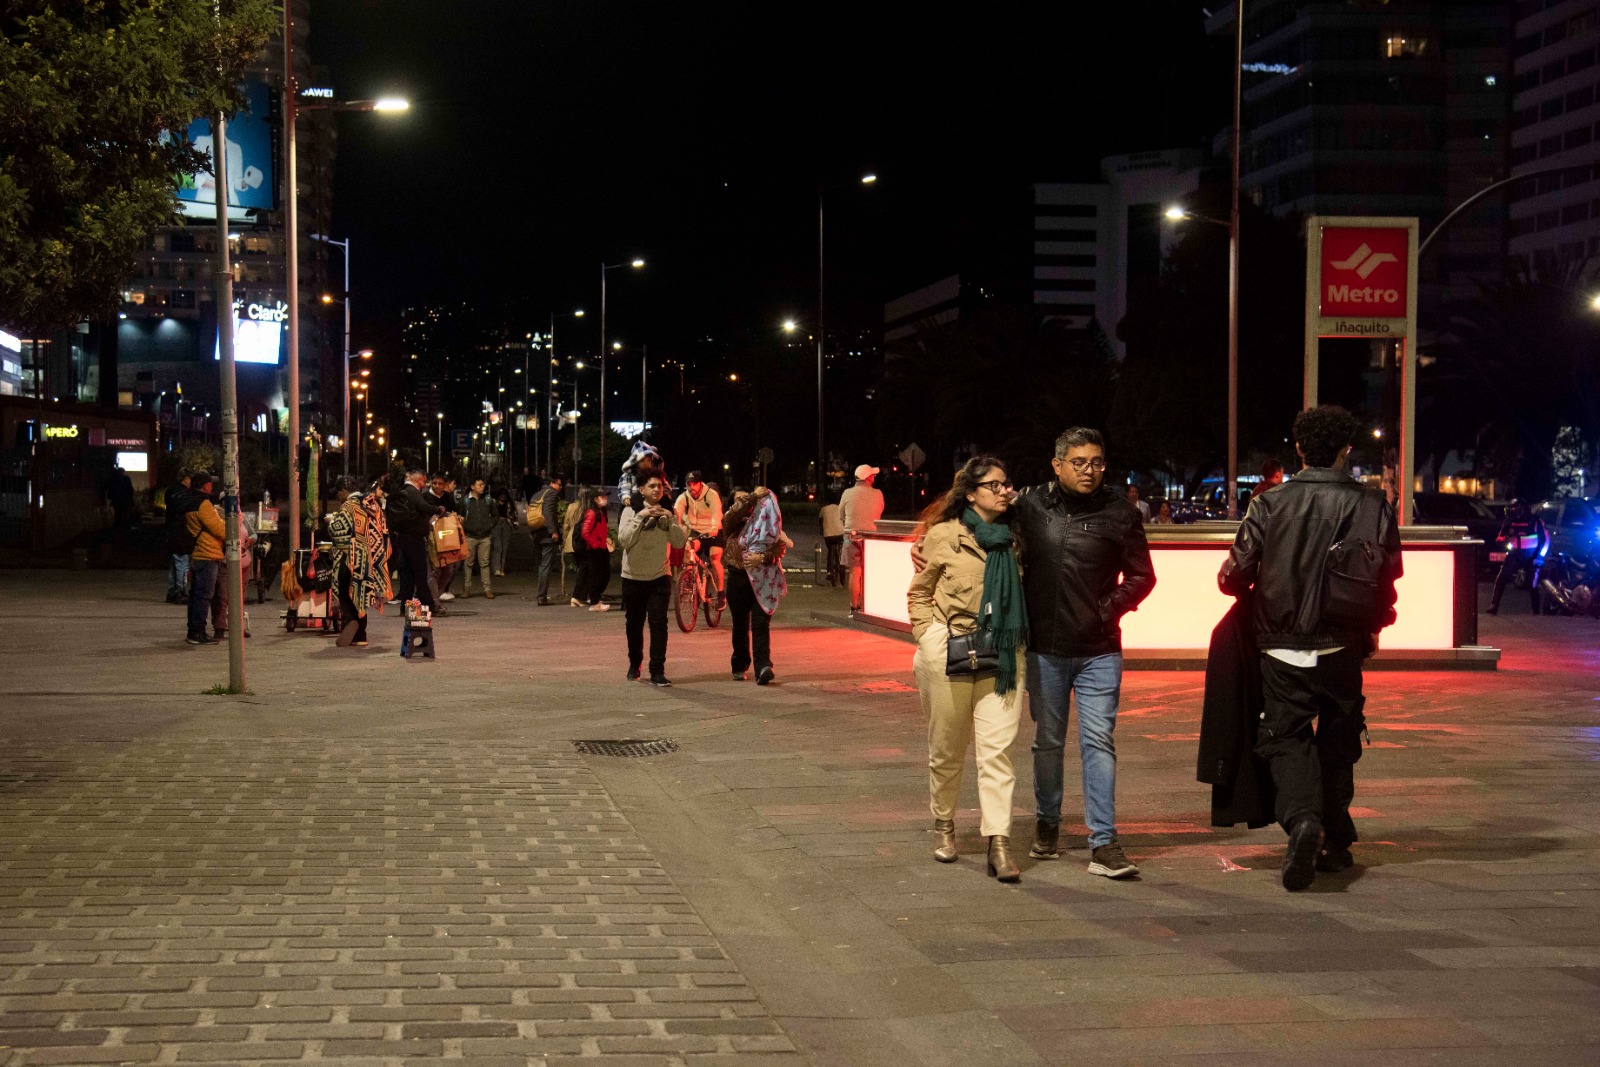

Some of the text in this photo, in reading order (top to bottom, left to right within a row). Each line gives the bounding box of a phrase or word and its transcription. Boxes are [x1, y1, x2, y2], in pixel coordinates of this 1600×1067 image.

[300, 88, 333, 98] AWEI
[1328, 285, 1399, 303] Metro
[248, 302, 285, 322] Claro
[456, 432, 468, 448] E
